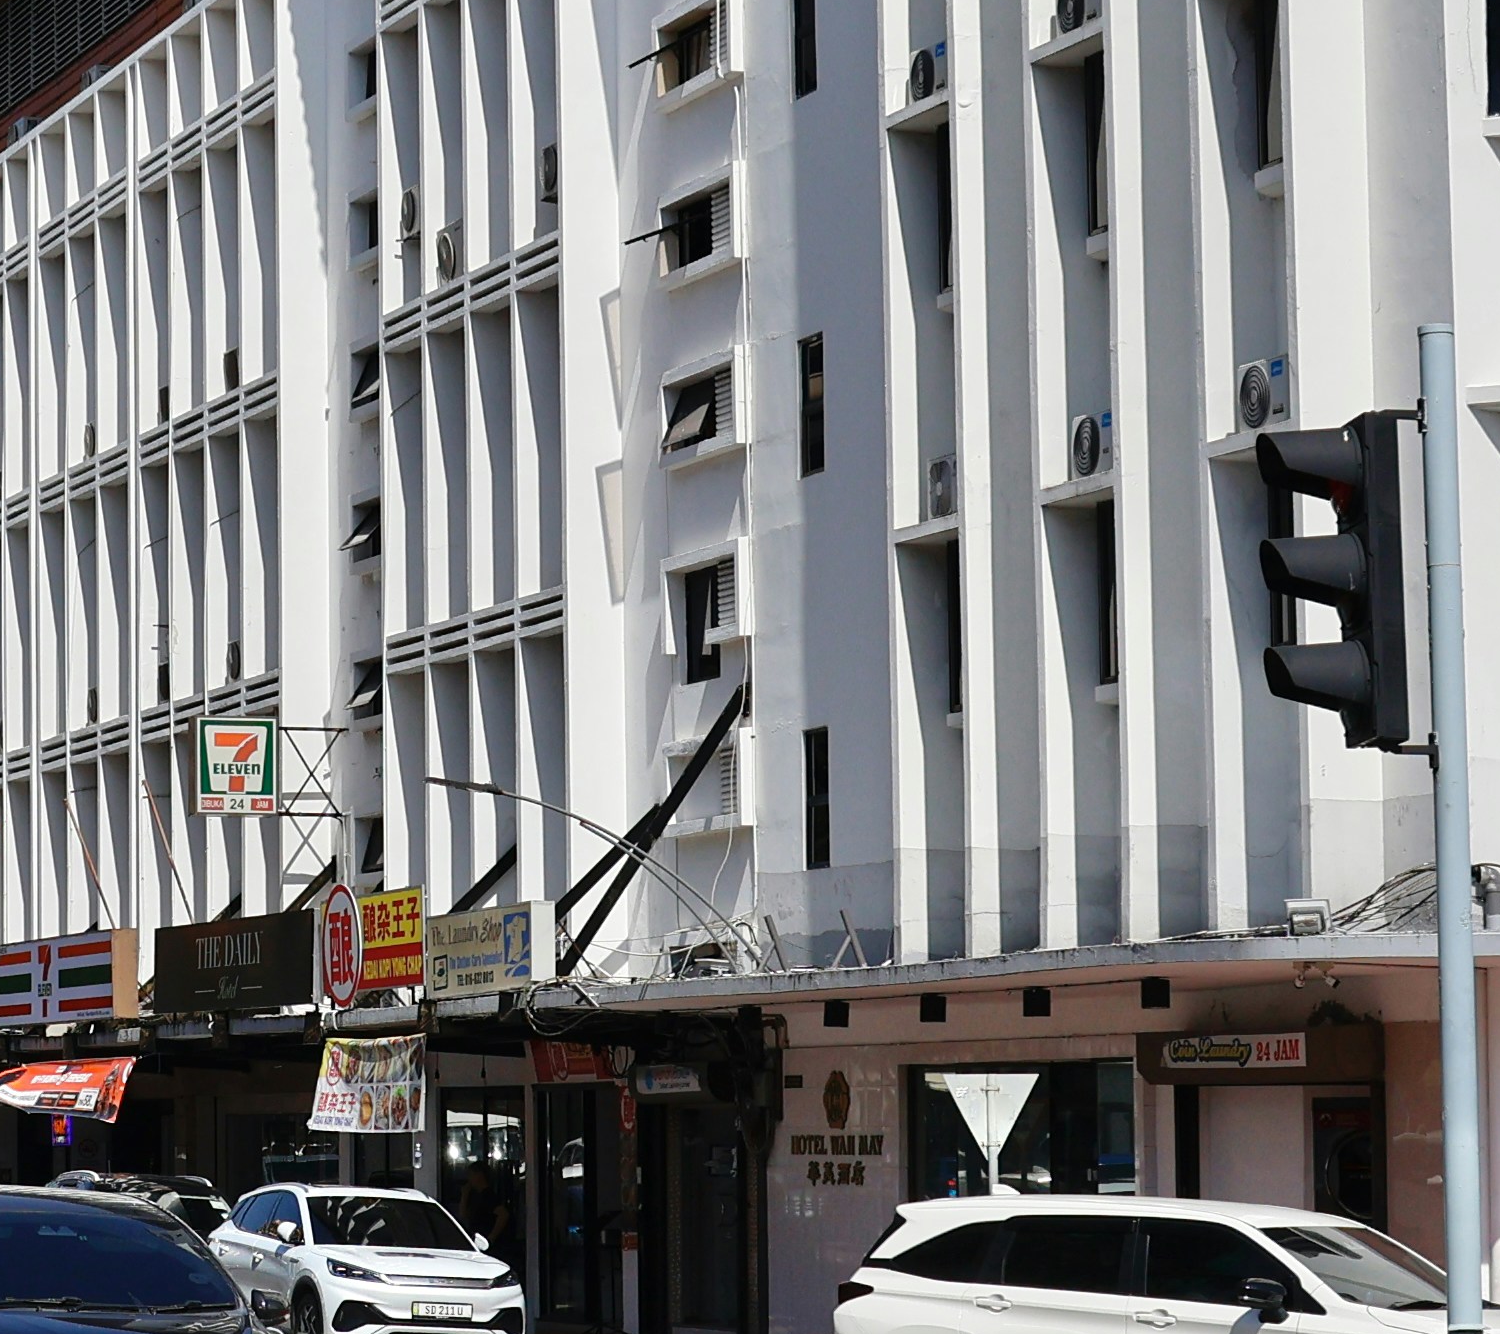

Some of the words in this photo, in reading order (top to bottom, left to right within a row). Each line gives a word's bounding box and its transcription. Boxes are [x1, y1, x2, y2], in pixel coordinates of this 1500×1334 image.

[213, 763, 261, 775] ELEVEn
[214, 732, 258, 793] 7
[230, 799, 244, 809] 24
[256, 800, 269, 808] JAM
[362, 896, 420, 944] 酿杂王子
[196, 936, 222, 970] THE
[223, 930, 263, 967] DAILY
[329, 907, 355, 986] 酿
[363, 959, 379, 981] KEDAI
[379, 958, 392, 979] KOPI
[392, 956, 407, 978] YONG
[407, 954, 422, 975] CHAP
[1168, 1038, 1198, 1063] Coin
[1198, 1036, 1252, 1067] Laundry
[1256, 1042, 1271, 1061] 24
[1274, 1038, 1300, 1061] JAM
[790, 1134, 828, 1155] HOTEL
[830, 1135, 856, 1156] WAH
[858, 1134, 884, 1156] MAY
[425, 1305, 437, 1315] SD
[439, 1306, 455, 1316] 211
[457, 1306, 464, 1316] U
